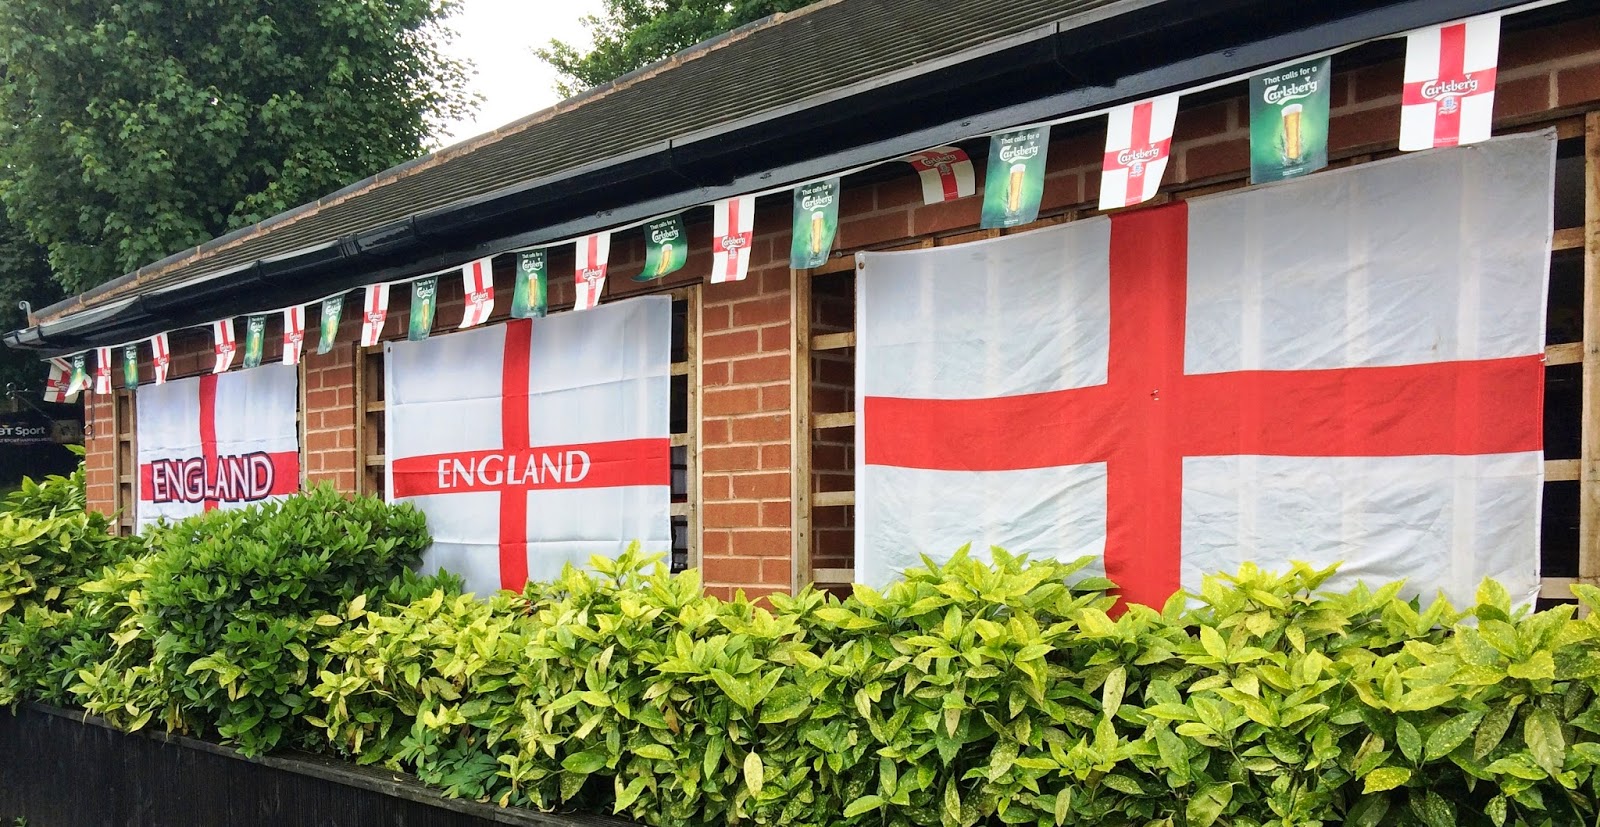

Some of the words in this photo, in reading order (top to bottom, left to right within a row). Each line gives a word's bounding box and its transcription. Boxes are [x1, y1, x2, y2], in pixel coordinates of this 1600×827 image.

[1263, 75, 1280, 86] That
[1281, 70, 1299, 81] calls
[1299, 67, 1311, 76] for
[1263, 79, 1318, 105] Carlsberg
[1420, 78, 1479, 102] Carlsberg
[1000, 137, 1014, 145] That
[1013, 134, 1027, 143] calls
[1026, 133, 1035, 141] for
[920, 153, 957, 168] Carlsberg
[999, 144, 1039, 164] Carlsberg
[1117, 146, 1160, 168] Carlsberg
[801, 193, 834, 212] Carlsberg
[651, 227, 680, 245] Carlsberg
[721, 235, 746, 251] Carlsberg
[15, 426, 46, 437] Sport
[151, 450, 275, 504] ENGLAND
[437, 449, 591, 489] ENGLAND
